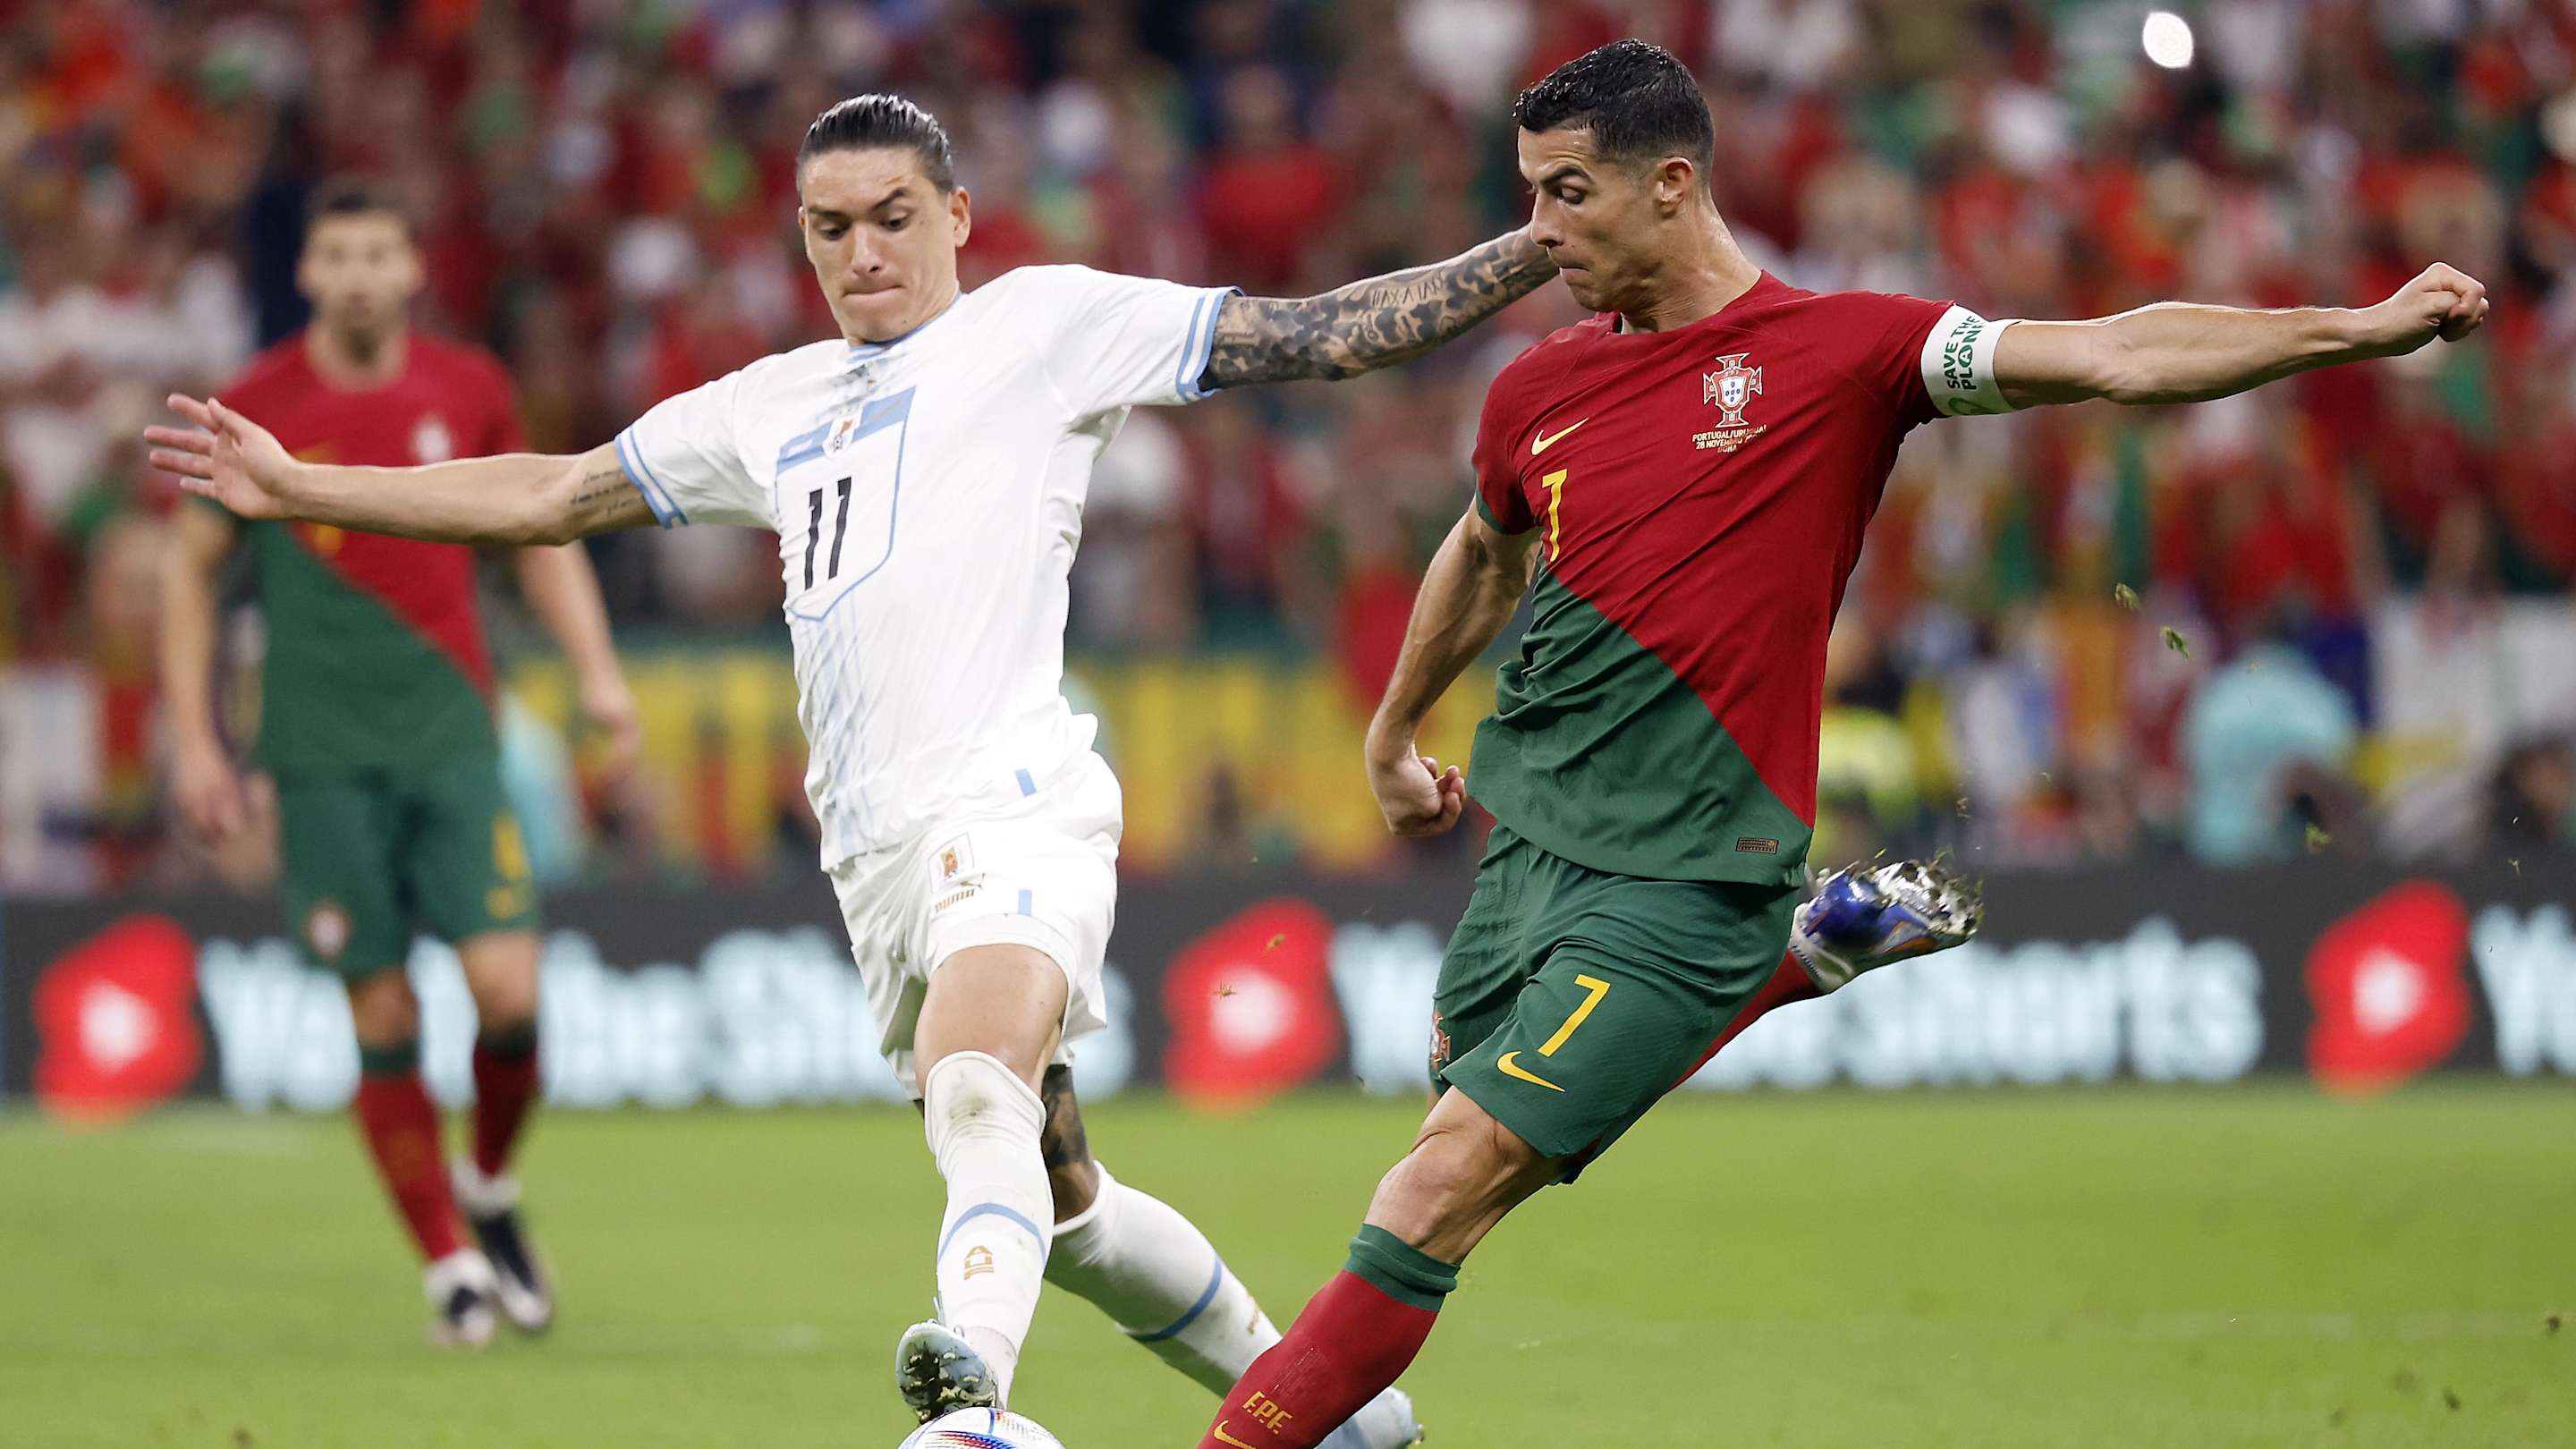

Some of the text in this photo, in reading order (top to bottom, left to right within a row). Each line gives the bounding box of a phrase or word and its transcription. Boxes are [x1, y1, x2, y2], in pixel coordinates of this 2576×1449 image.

[1944, 316, 1979, 389] SAVE THE
[1958, 319, 1986, 390] PLANE
[804, 476, 852, 591] 11
[1542, 468, 1568, 562] 7
[1538, 973, 1610, 1057] 7
